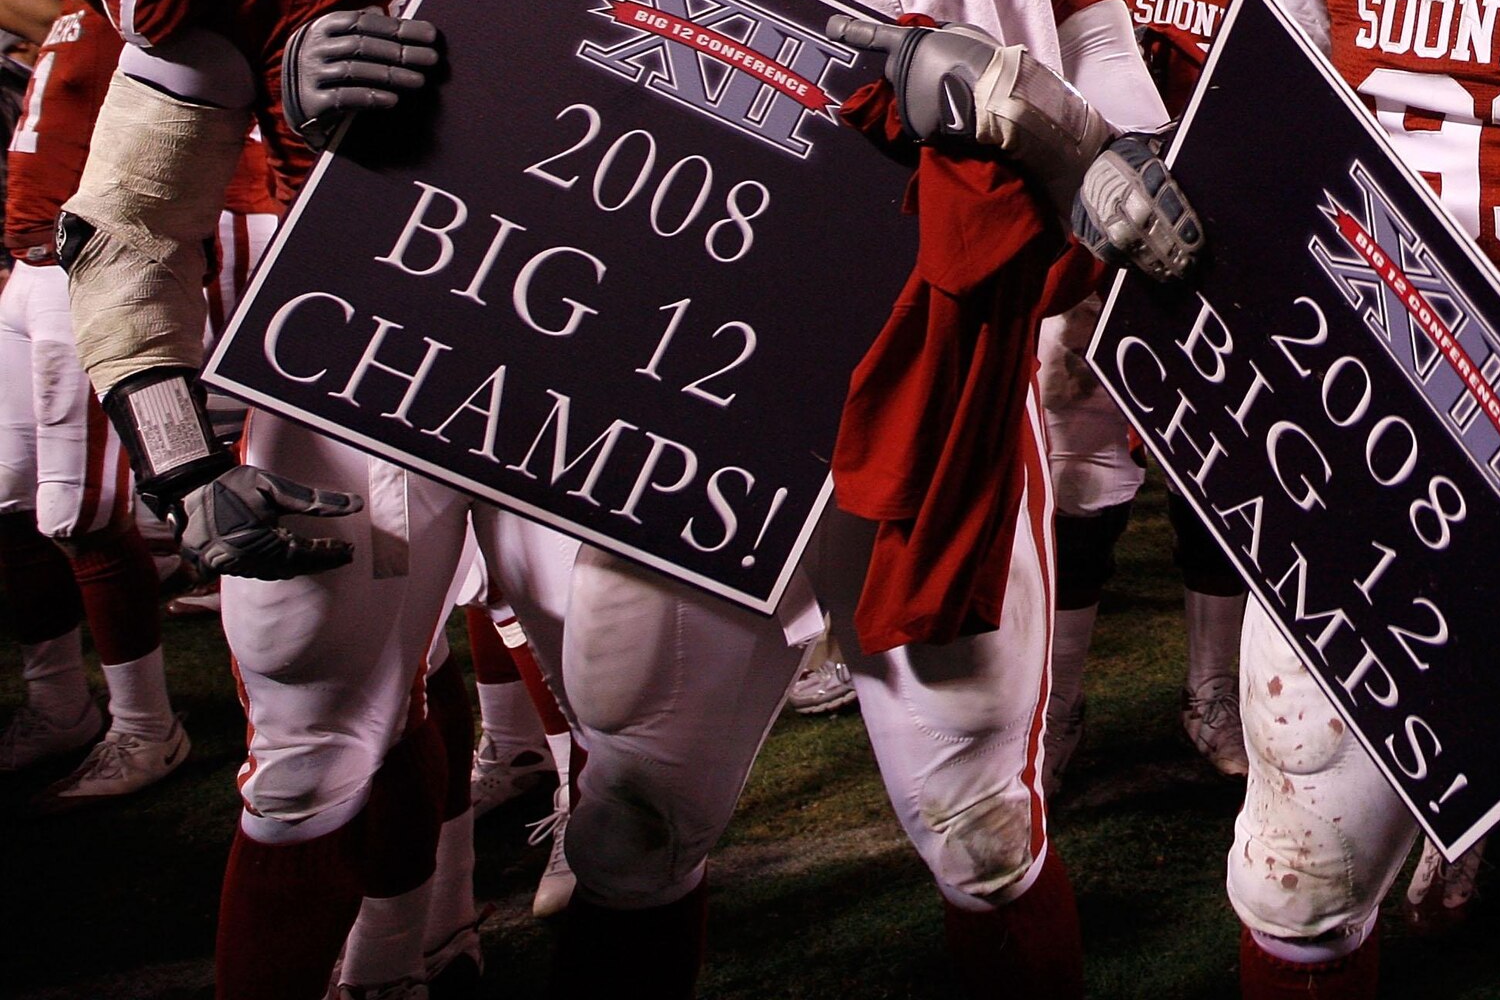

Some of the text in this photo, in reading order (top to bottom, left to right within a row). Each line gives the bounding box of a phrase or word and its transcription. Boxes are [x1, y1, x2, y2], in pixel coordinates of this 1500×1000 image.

[634, 9, 809, 97] BIG 12 CONFERENCE
[374, 181, 759, 408] BIG 12
[524, 103, 771, 264] 2008
[1354, 231, 1385, 267] BIG
[1386, 268, 1407, 295] 12
[263, 291, 788, 568] CHAMPS!
[1173, 293, 1454, 672] BIG 12
[1270, 296, 1468, 551] 2008
[1112, 334, 1470, 814] CHAMPS!
